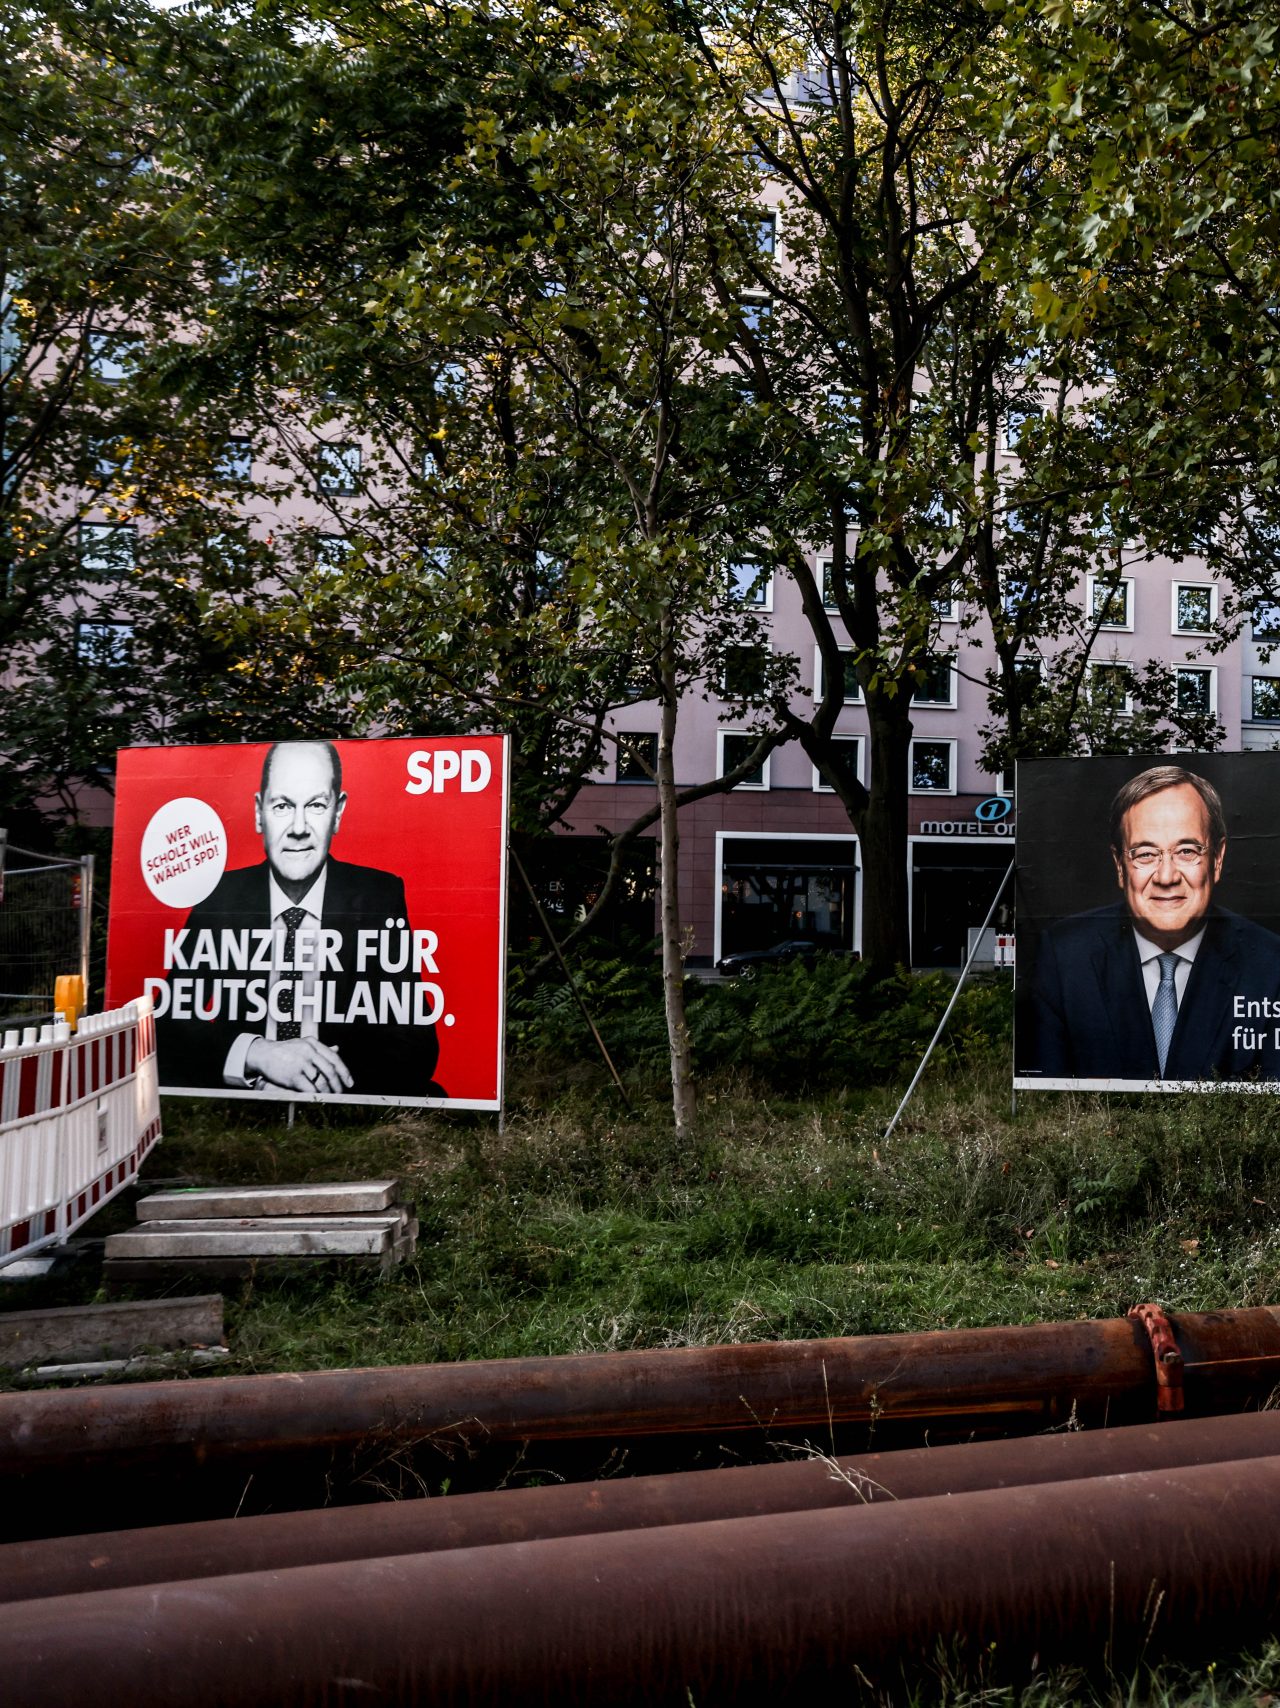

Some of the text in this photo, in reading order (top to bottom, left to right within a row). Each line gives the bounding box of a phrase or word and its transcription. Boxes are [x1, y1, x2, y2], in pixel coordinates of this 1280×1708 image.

[405, 750, 492, 795] SPD
[146, 830, 219, 872] SCHOLZ WILL,
[166, 825, 191, 845] WER
[153, 845, 219, 885] WÄHLT SPD!
[163, 917, 440, 974] KANZLER FÜR
[143, 976, 456, 1027] DEUTSCHLAND.
[1232, 1025, 1267, 1050] für
